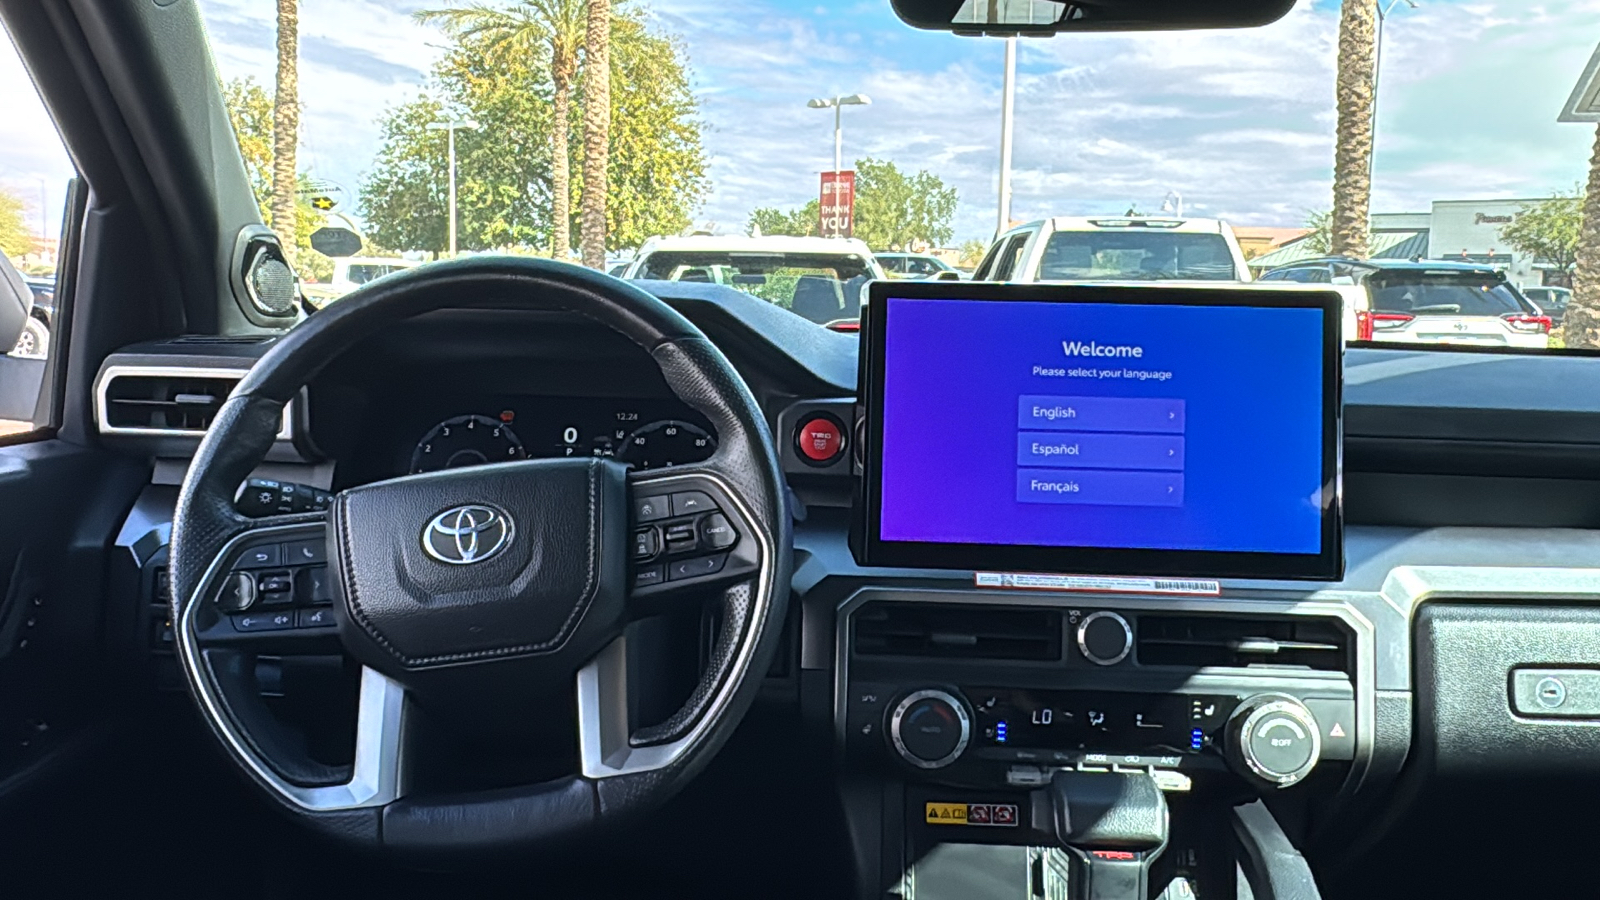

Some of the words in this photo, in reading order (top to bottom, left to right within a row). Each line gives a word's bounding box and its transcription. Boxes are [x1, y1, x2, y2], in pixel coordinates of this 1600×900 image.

[821, 205, 850, 214] THANK
[821, 216, 849, 230] YOU
[1062, 341, 1143, 358] Welcome
[1032, 366, 1066, 377] Please
[1067, 367, 1097, 378] select
[1098, 370, 1122, 379] your
[1123, 368, 1172, 381] language
[1032, 406, 1076, 420] English
[443, 428, 450, 436] 3
[493, 429, 500, 437] 5
[665, 427, 677, 435] 60
[634, 437, 646, 445] 40
[695, 438, 706, 447] 80
[425, 444, 431, 453] 2
[508, 446, 515, 455] 6
[566, 447, 574, 456] P
[1031, 442, 1080, 456] Español
[1030, 479, 1080, 494] Français
[1278, 738, 1292, 746] OFF
